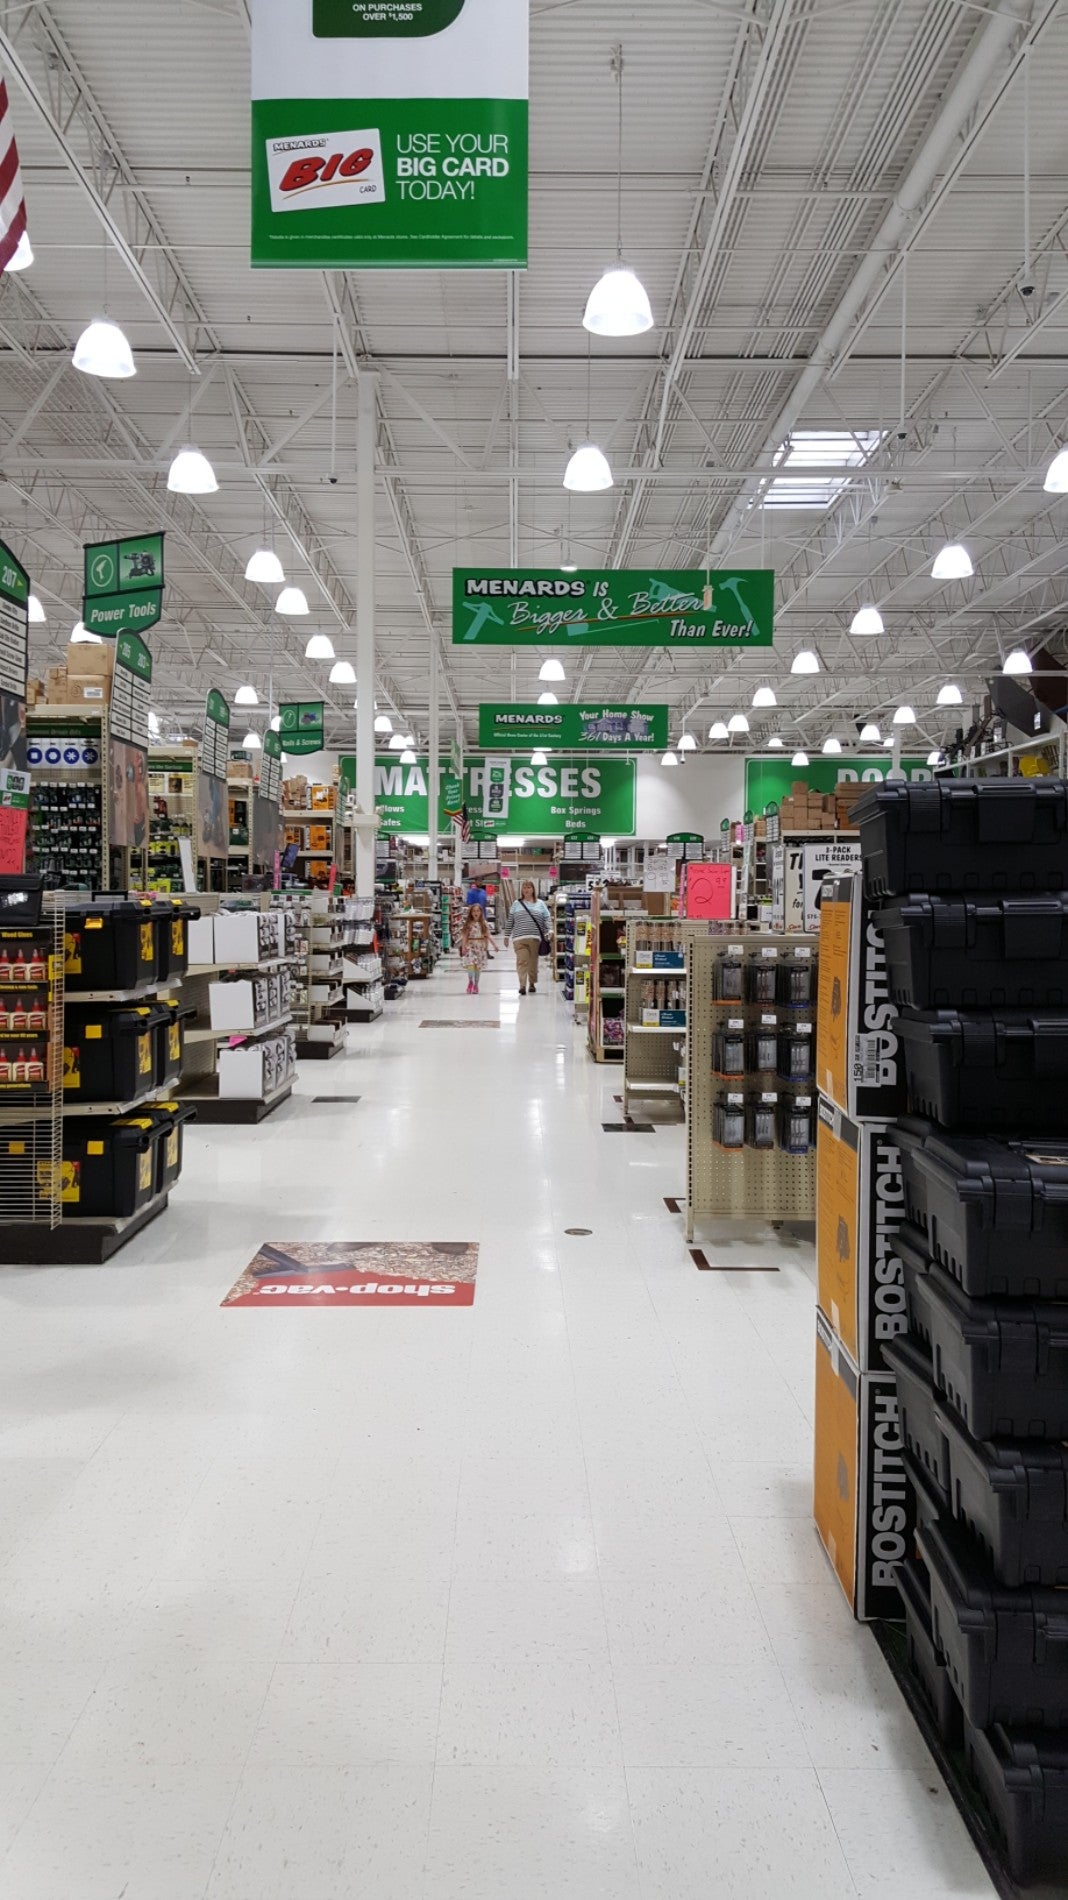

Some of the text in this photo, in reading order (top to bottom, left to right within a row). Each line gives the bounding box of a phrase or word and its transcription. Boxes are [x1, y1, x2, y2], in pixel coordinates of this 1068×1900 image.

[352, 3, 423, 11] ON PURCHASES
[388, 12, 413, 21] $1,500
[273, 139, 326, 152] MENARDS
[396, 134, 508, 153] USE YOUR
[279, 148, 374, 191] BIG
[396, 158, 509, 177] BIG CARD
[359, 185, 378, 194] CARD
[396, 181, 475, 200] TODAY!
[2, 565, 17, 588] 207
[465, 578, 610, 597] MENARDS IS
[91, 602, 157, 623] Power Tools
[507, 591, 705, 635] Bigger & Better
[670, 619, 752, 637] Than Ever!
[494, 714, 563, 725] MENARDS
[579, 709, 655, 721] Your Home Show
[602, 732, 622, 743] Days
[624, 732, 631, 741] A
[634, 732, 655, 742] Year!
[375, 766, 601, 798] MARSSES
[551, 806, 601, 817] Box Springs
[565, 819, 586, 828] Beds
[864, 909, 898, 1086] BOSTITC
[874, 1146, 909, 1340] BOSTITCH
[871, 1395, 907, 1588] BOSTITCH
